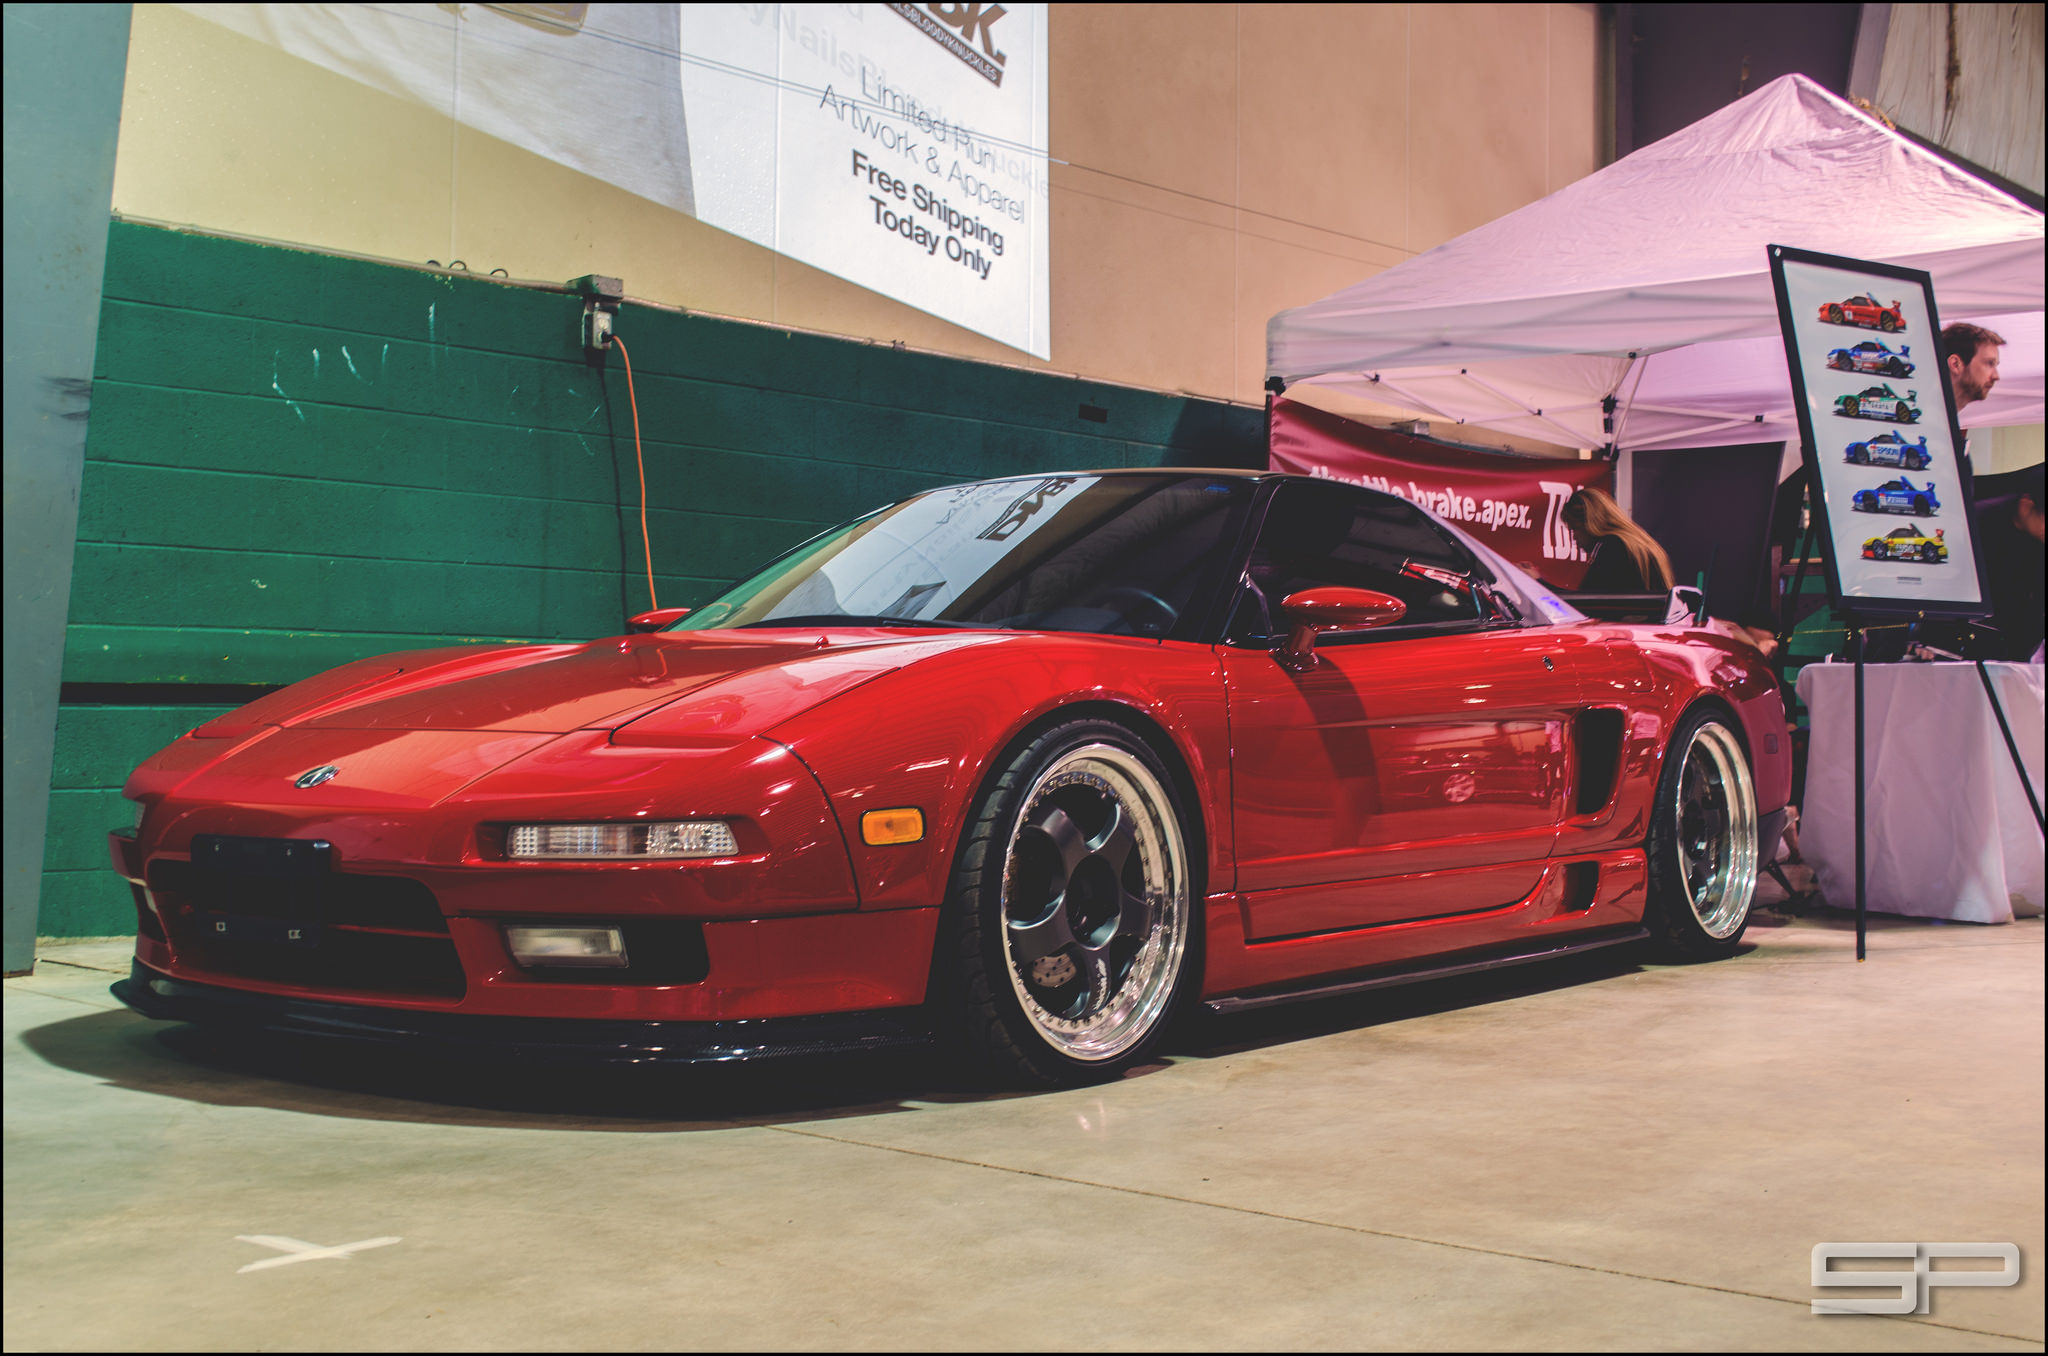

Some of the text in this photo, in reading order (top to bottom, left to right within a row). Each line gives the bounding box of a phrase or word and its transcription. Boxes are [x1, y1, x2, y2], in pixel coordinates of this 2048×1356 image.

[819, 84, 1025, 224] Artwork & Apparel
[862, 65, 996, 174] Limited Run
[852, 149, 1004, 256] Free Shipping
[869, 195, 993, 280] Today Only
